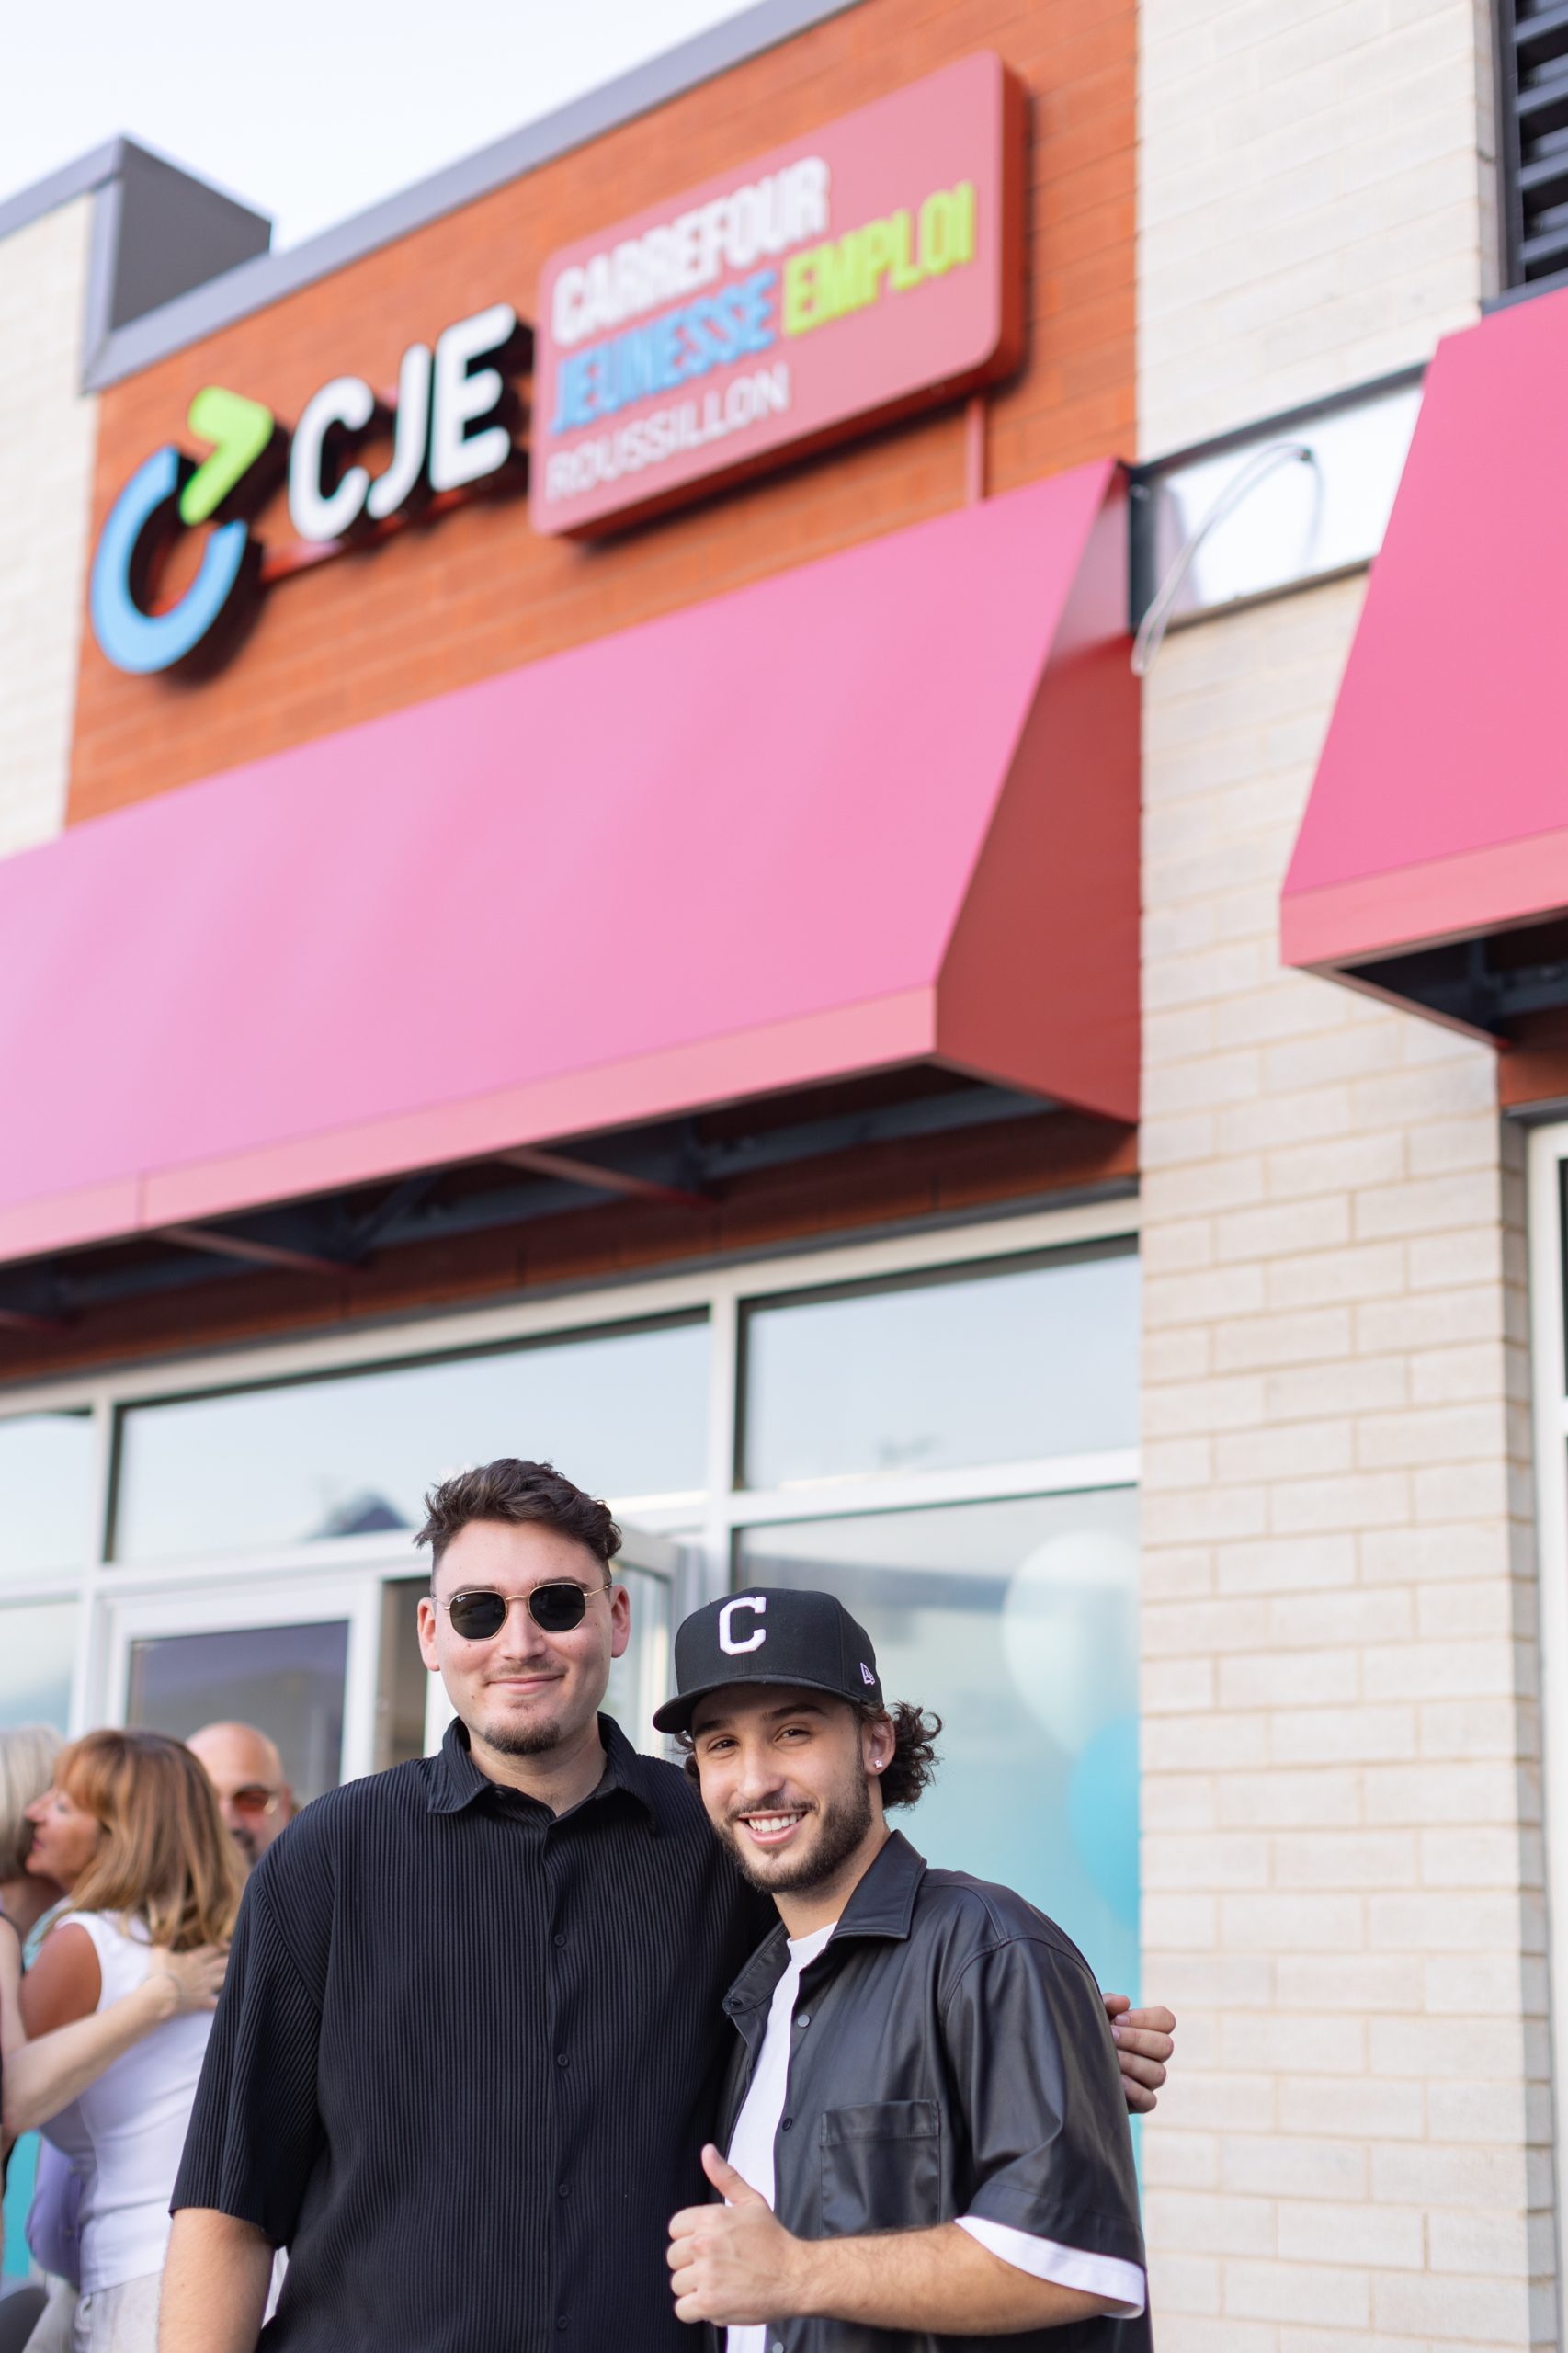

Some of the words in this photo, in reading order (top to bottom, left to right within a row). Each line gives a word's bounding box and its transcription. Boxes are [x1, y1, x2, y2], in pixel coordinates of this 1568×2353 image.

[550, 269, 778, 435] JEUNESSE
[783, 179, 977, 337] EMPLOI
[552, 155, 830, 346] CARREFOUR
[288, 303, 516, 542] CJE
[545, 363, 790, 504] ROUSSILLON
[719, 1597, 767, 1655] C
